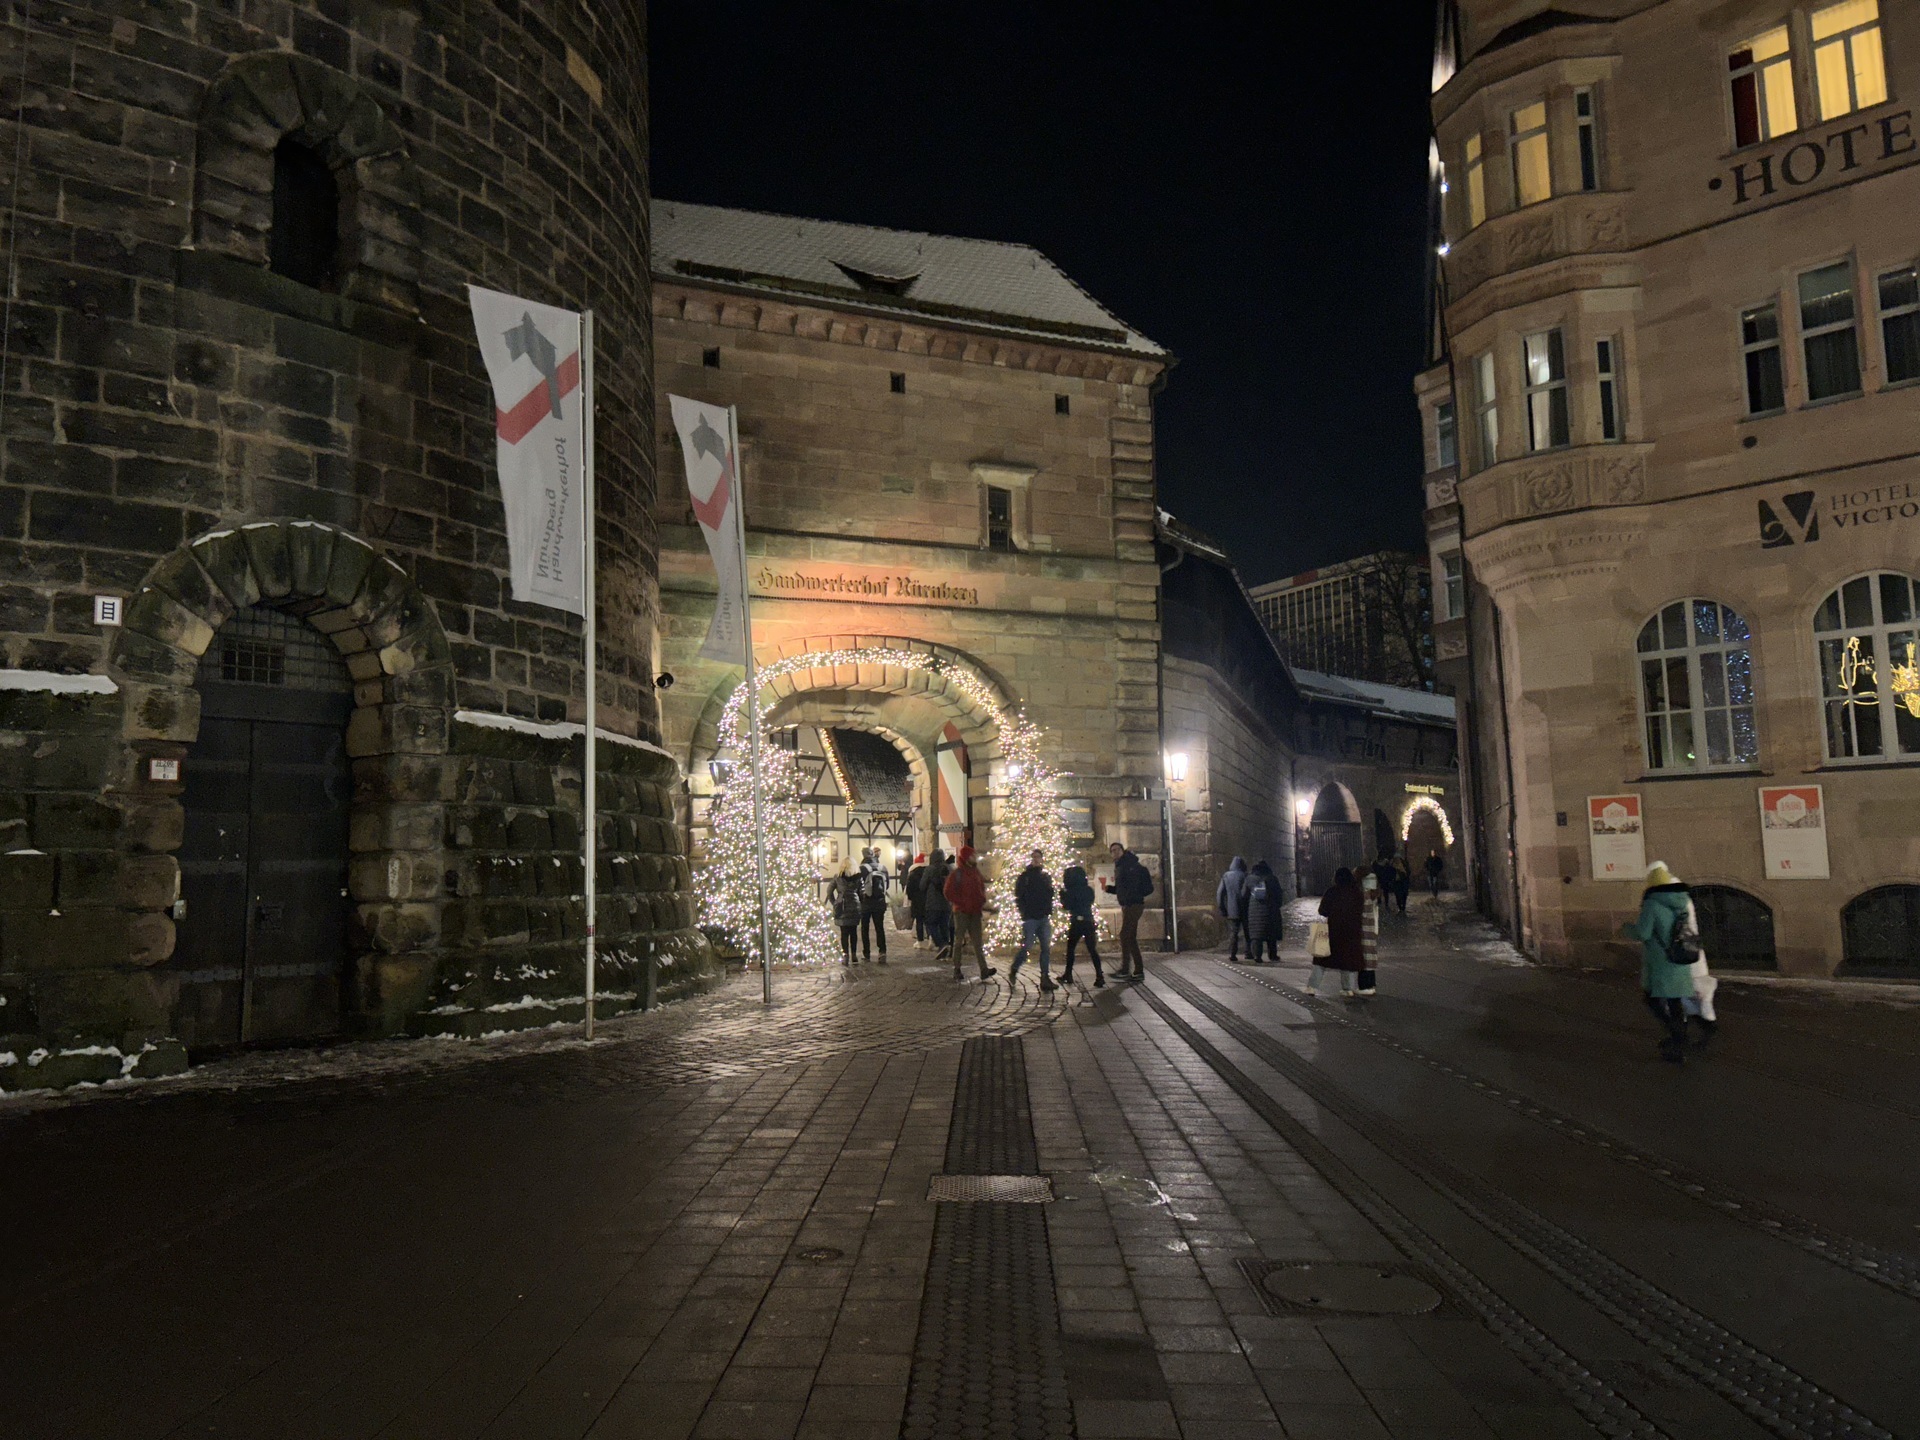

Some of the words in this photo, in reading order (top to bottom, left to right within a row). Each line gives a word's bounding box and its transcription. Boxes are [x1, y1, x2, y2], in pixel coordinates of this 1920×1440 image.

[1730, 110, 1917, 205] HOTE
[1831, 483, 1919, 511] HOTEL
[758, 567, 889, 597] Handwerkerhof
[895, 577, 979, 605] Nürnberg
